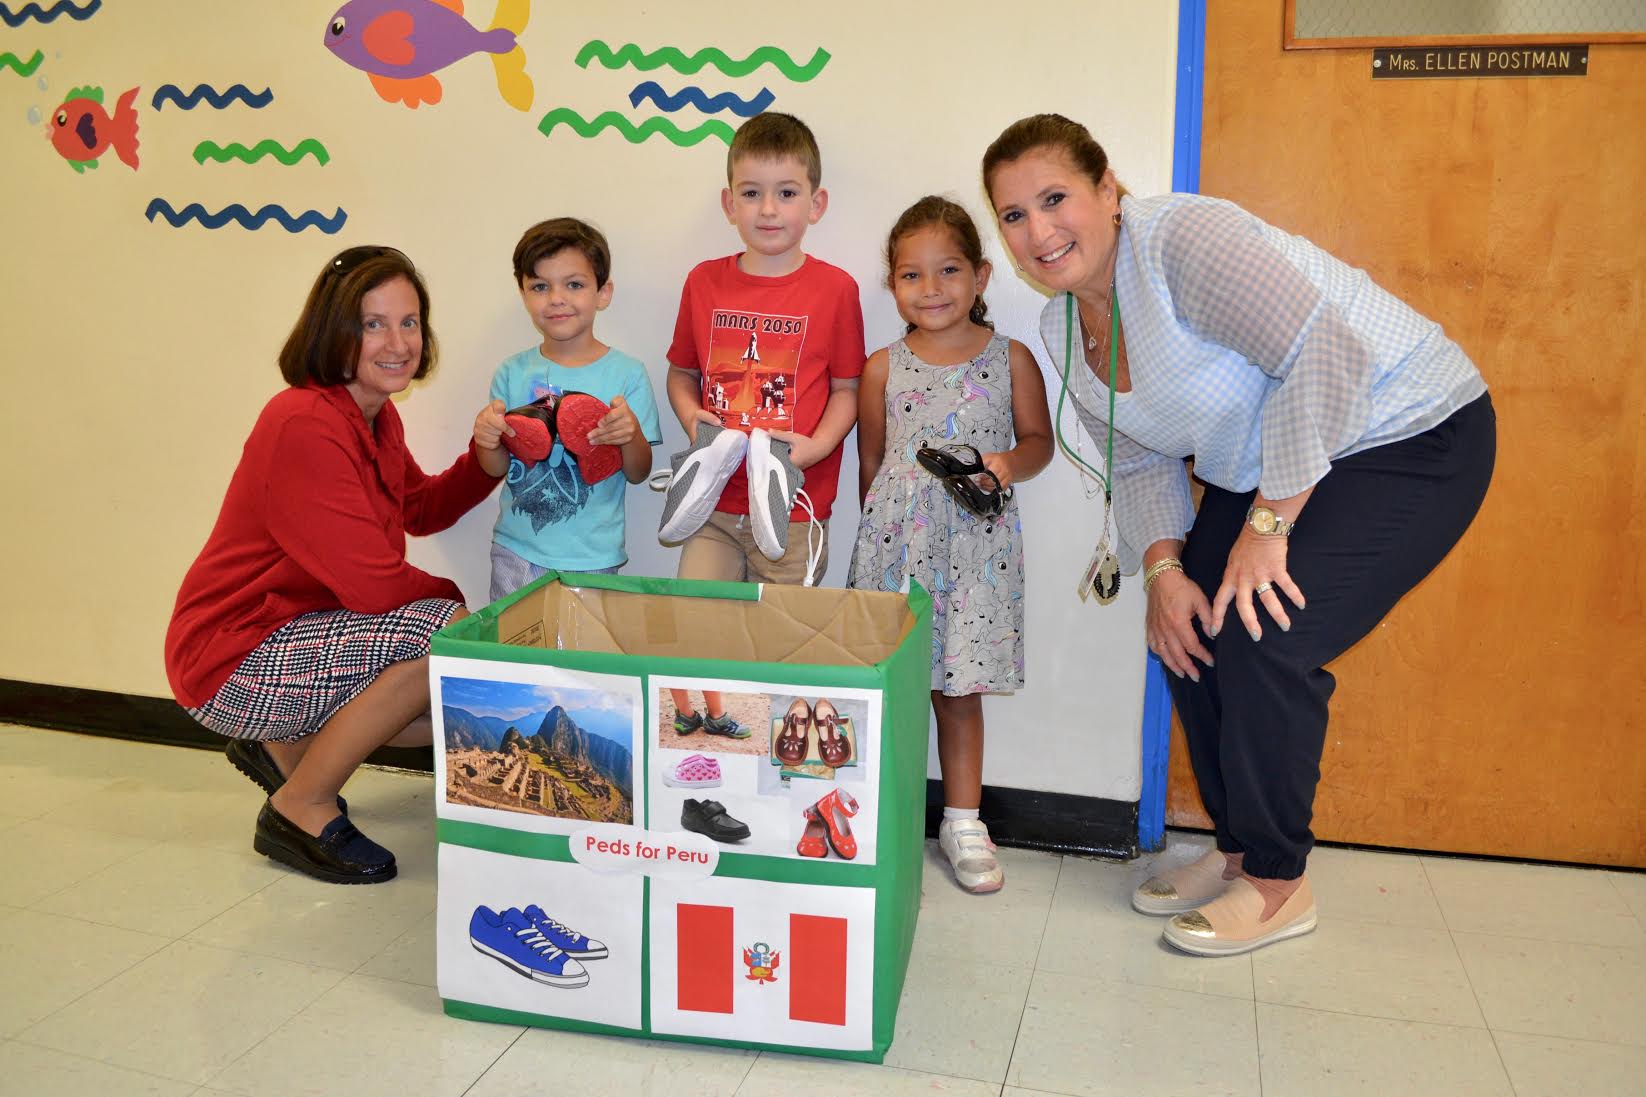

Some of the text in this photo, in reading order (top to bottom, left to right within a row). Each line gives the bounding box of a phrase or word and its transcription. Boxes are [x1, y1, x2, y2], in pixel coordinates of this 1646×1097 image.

[1425, 52, 1481, 70] ELLEN
[1487, 51, 1571, 69] POSTMAN
[715, 313, 802, 335] MARS 2050
[586, 836, 709, 864] Peds for Peru
